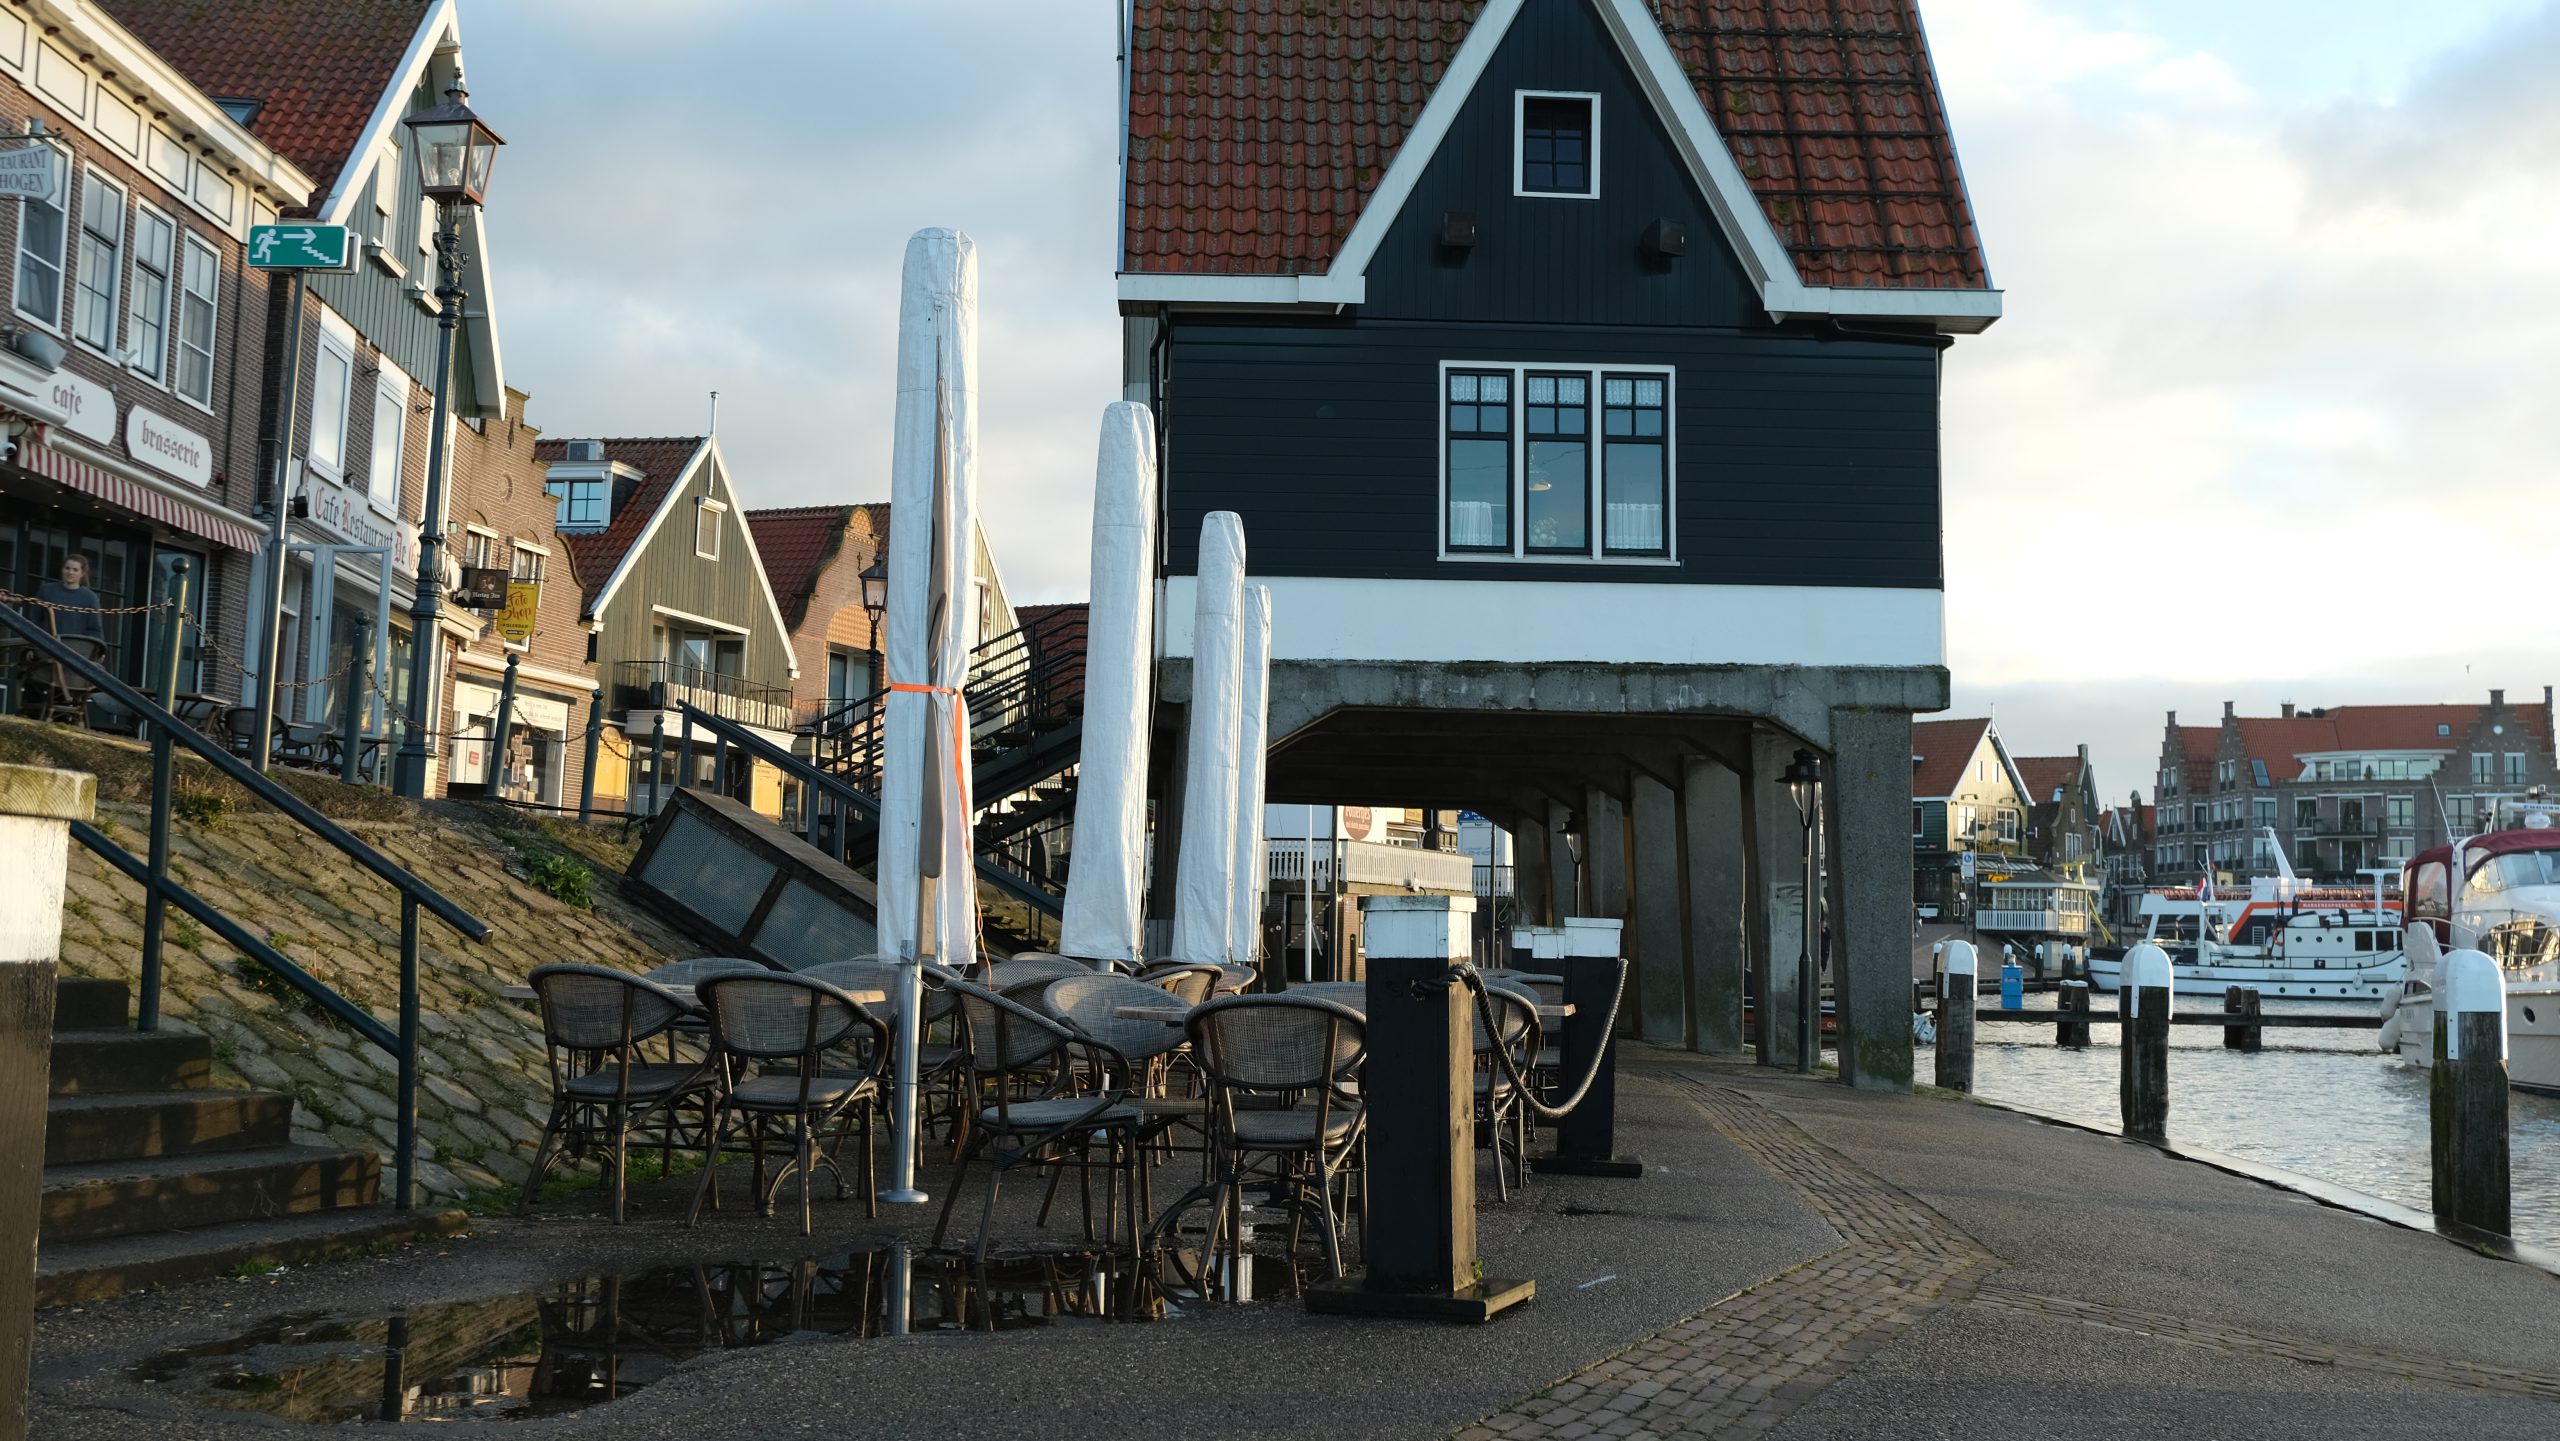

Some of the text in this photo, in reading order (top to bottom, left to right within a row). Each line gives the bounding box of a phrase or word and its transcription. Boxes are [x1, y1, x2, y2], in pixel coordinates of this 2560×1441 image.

[53, 384, 82, 416] café
[142, 420, 201, 468] brasserie
[314, 486, 339, 527] Cafe
[341, 499, 393, 548] Restaurant
[394, 531, 407, 565] De
[502, 604, 532, 621] Shop
[507, 590, 529, 607] Foto
